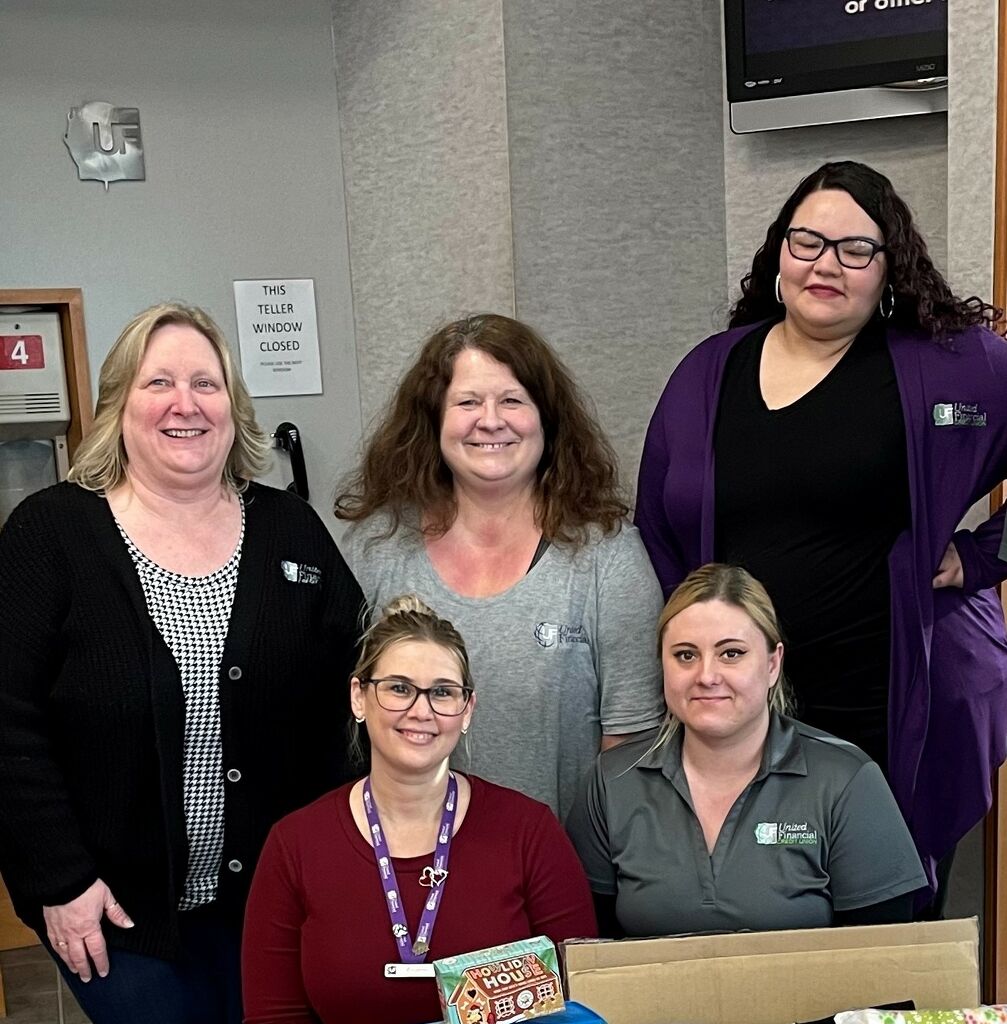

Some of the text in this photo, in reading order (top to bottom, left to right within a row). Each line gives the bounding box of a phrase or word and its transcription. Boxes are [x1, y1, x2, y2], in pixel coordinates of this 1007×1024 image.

[262, 285, 286, 296] THIS
[257, 303, 294, 315] TELLER
[252, 322, 303, 333] WINDOW
[260, 340, 300, 352] CLOSED
[11, 340, 28, 364] 4
[779, 822, 808, 832] United
[778, 830, 817, 840] Financial
[482, 963, 543, 989] HOUSE
